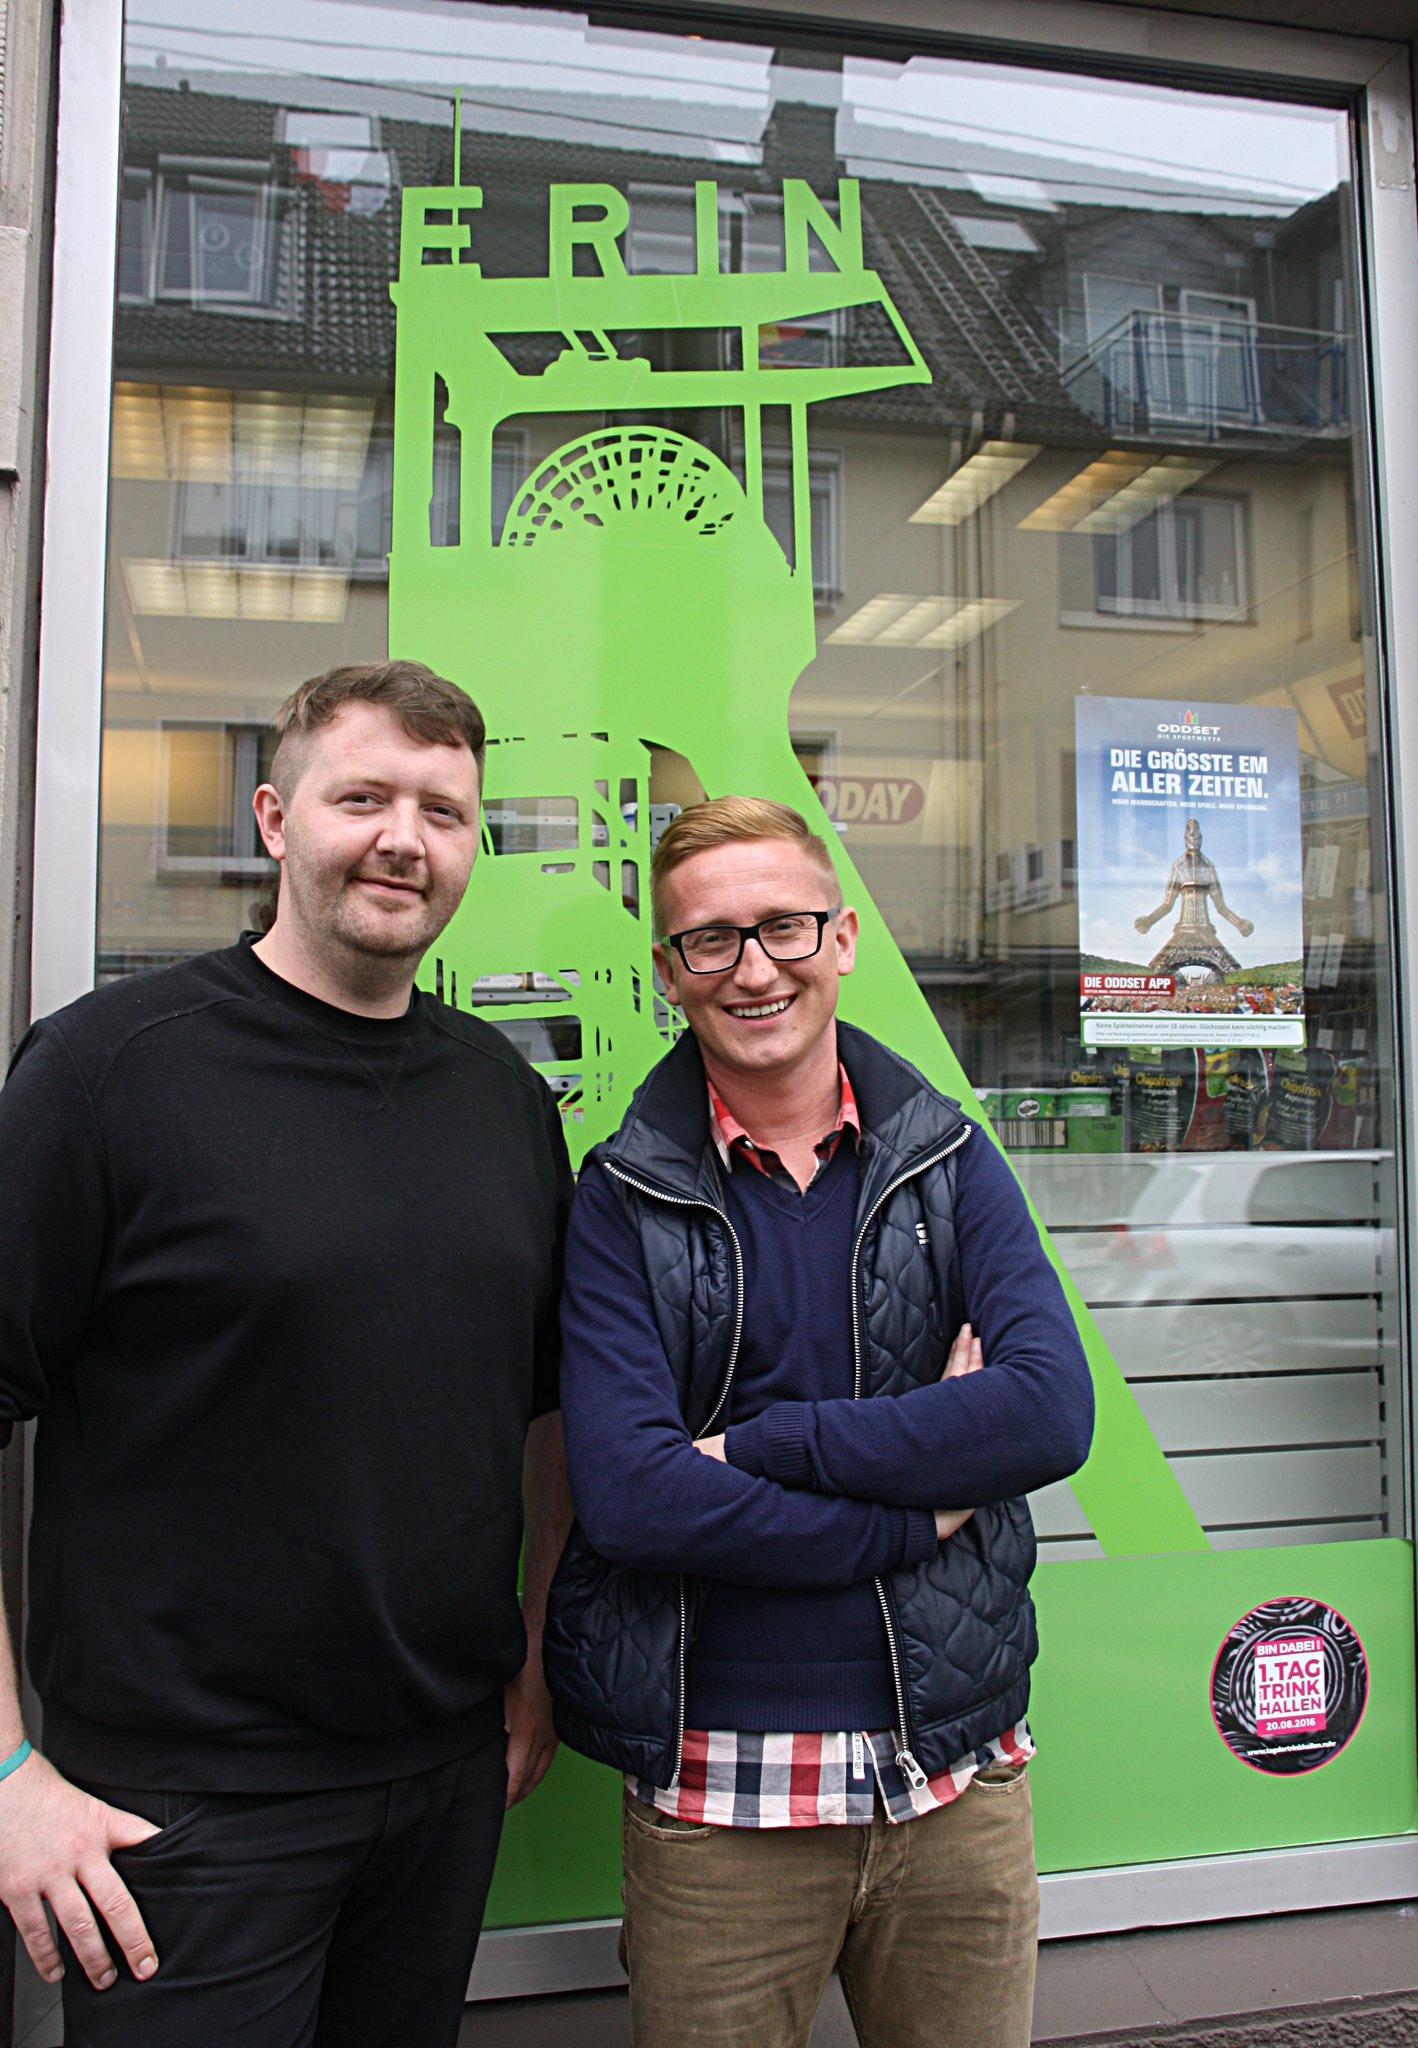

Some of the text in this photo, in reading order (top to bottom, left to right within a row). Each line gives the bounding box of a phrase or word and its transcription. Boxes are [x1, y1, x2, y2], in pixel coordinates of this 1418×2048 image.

[401, 178, 864, 278] ERIN
[1157, 723, 1221, 735] ODDSET
[1110, 748, 1268, 774] DIE GRÖSSTE EM
[1111, 771, 1269, 798] ALLER ZEITEN.
[814, 780, 913, 821] ODAY
[1084, 976, 1171, 989] DIE ODDSET APP
[1257, 1644, 1278, 1656] BIN
[1259, 1679, 1320, 1700] TRINK
[1259, 1697, 1321, 1715] HALLEN
[1266, 1717, 1316, 1731] 20.08.2016
